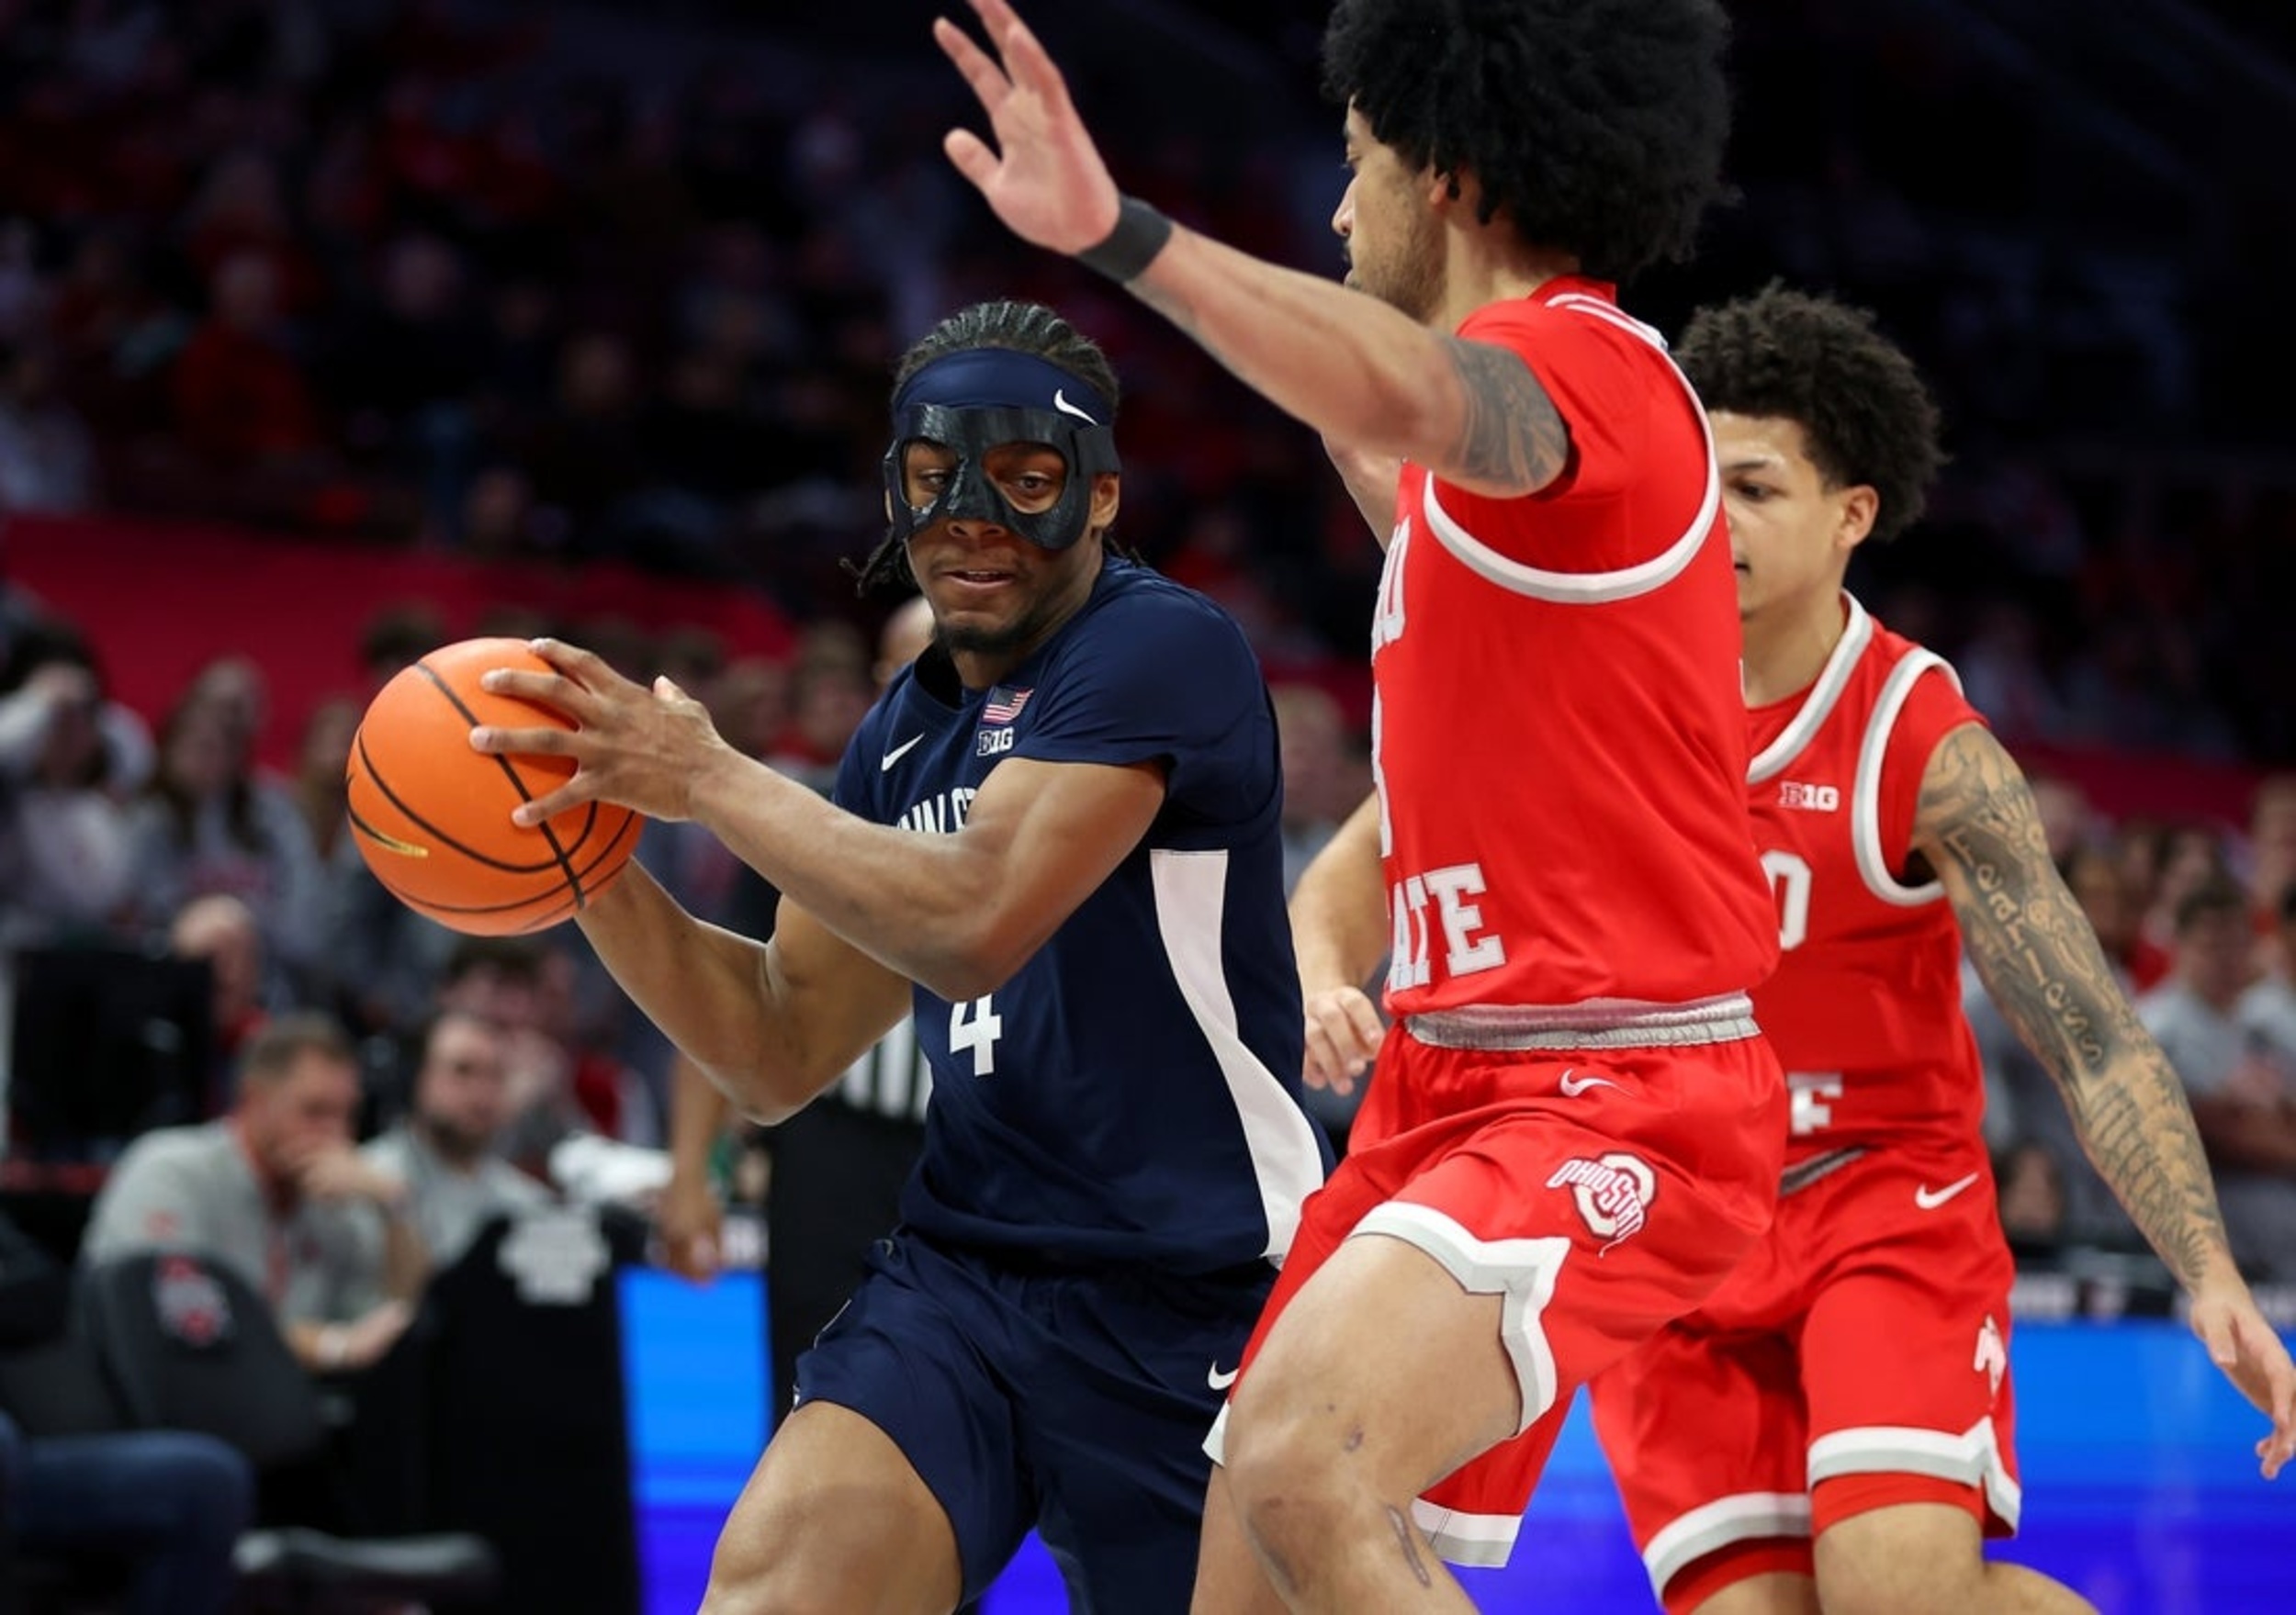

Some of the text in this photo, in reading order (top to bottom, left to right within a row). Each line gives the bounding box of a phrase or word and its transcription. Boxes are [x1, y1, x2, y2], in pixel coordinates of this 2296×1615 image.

[1387, 861, 1507, 993] ATE
[1941, 828, 2103, 1059] Fearless
[950, 993, 1002, 1077] 4
[1545, 1158, 1617, 1194] OHIO
